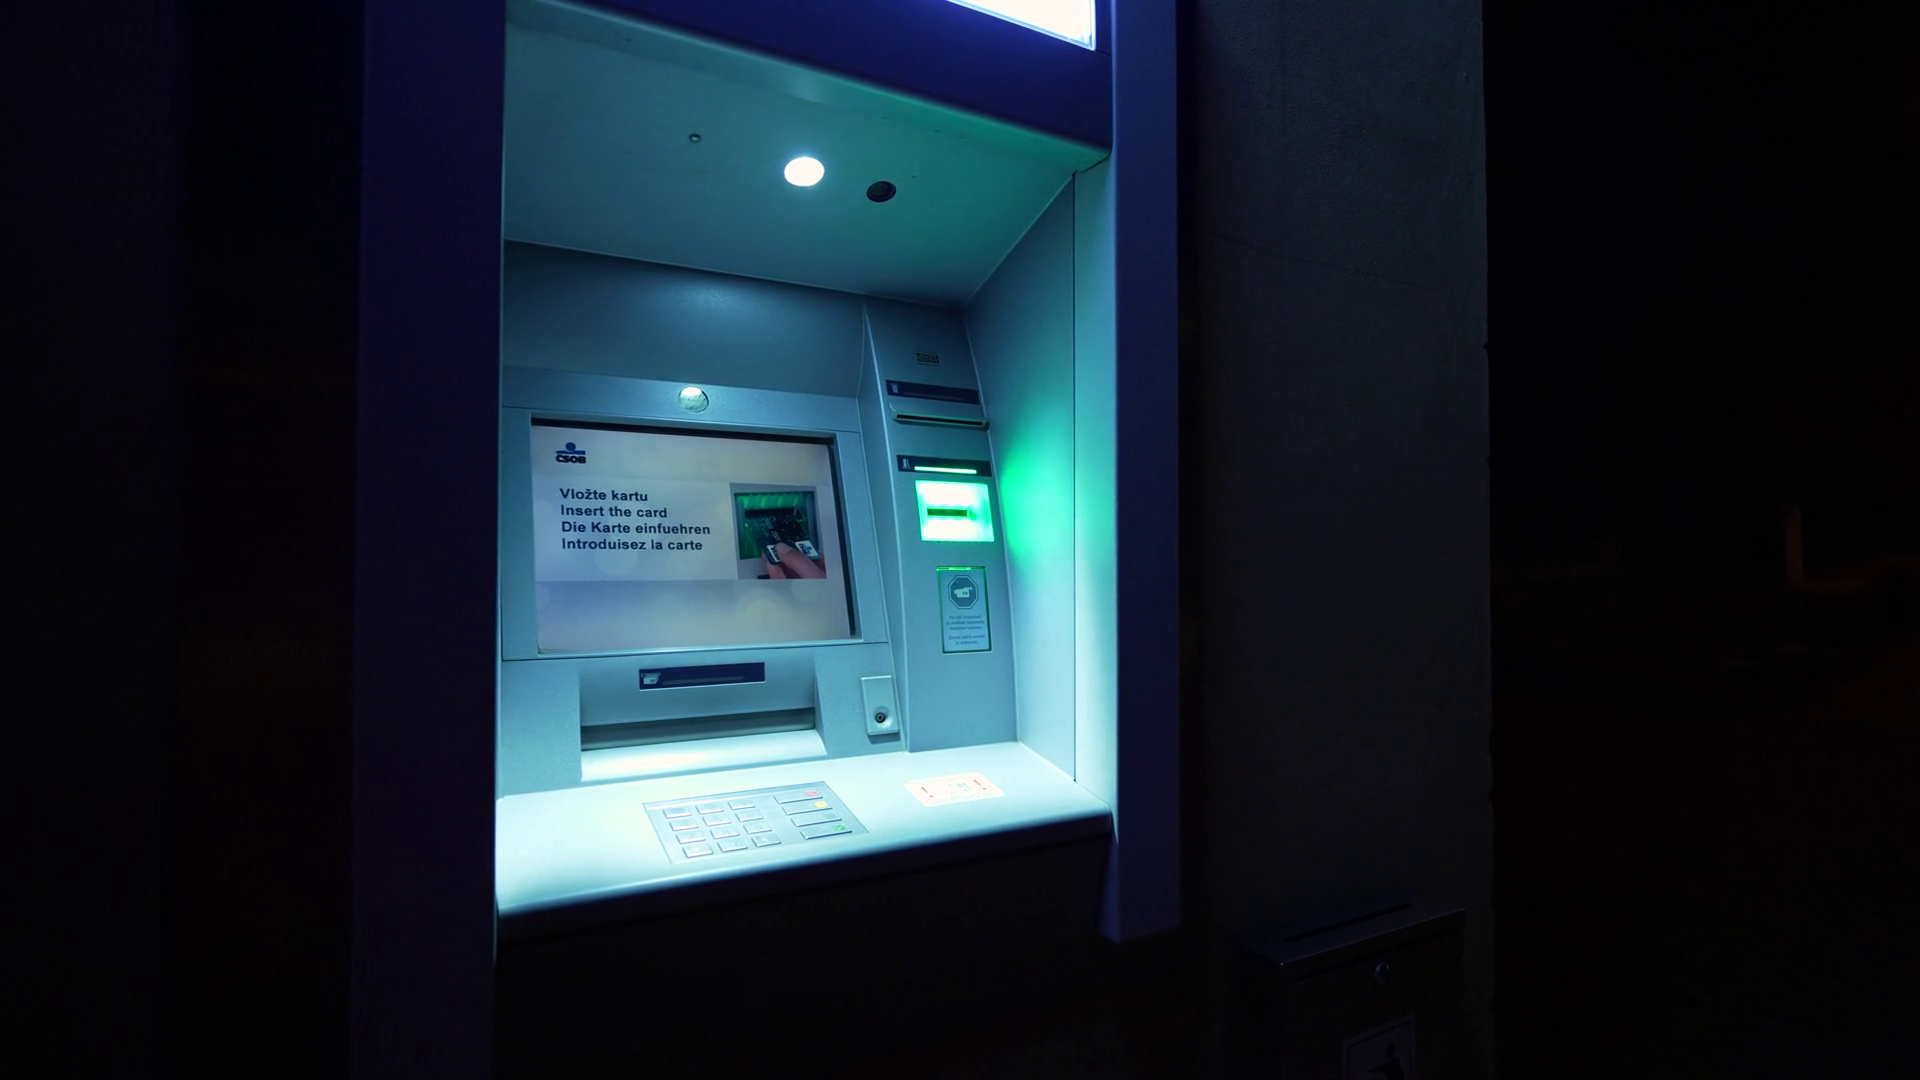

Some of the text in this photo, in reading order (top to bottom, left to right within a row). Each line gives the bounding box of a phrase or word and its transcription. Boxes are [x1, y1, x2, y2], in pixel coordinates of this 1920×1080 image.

[559, 487, 648, 502] Vložte kartu
[560, 505, 668, 518] Insert the card
[561, 521, 711, 535] Die Karte einfuehren
[562, 538, 703, 551] Introduisez la carte
